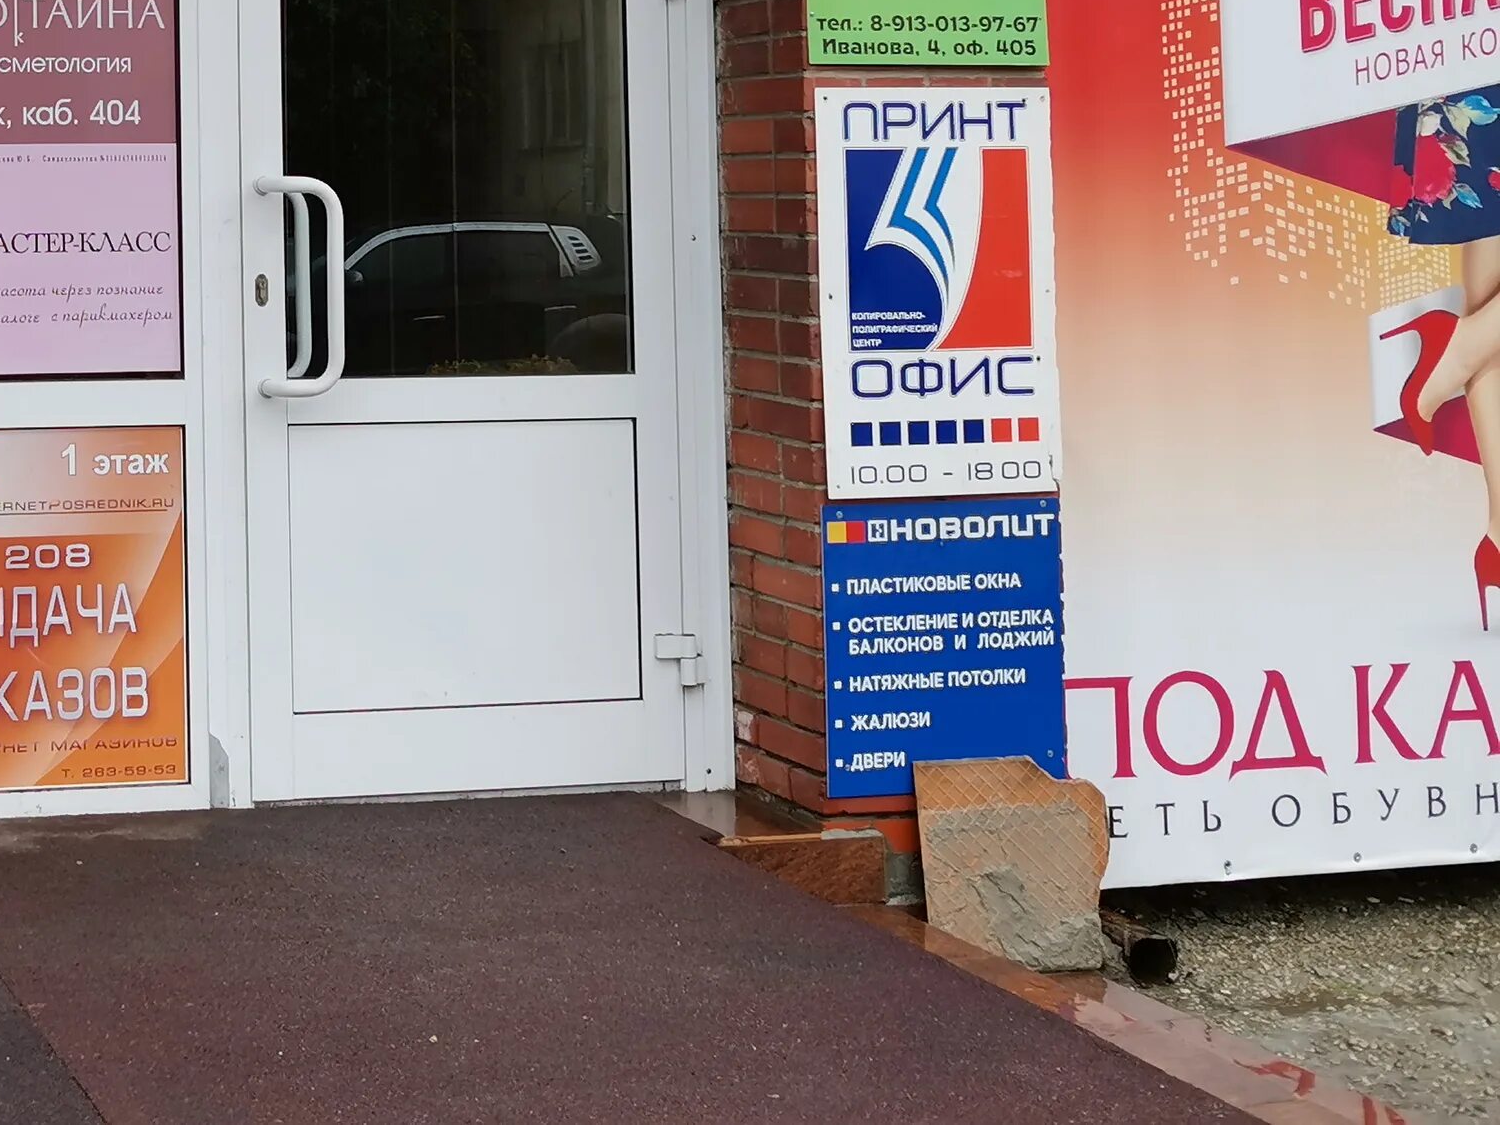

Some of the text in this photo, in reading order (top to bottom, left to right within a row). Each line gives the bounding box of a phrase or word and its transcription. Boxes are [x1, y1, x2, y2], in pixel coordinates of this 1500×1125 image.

[817, 15, 1038, 32] тел.: 8-913-013-97-67
[822, 38, 1036, 56] Иванова, 4, оф. 405
[1355, 28, 1497, 85] НОВАЯ КО
[22, 99, 78, 126] каб.
[89, 100, 141, 126] 404
[843, 102, 1026, 141] ПРИНТ
[51, 284, 92, 305] через
[96, 280, 163, 296] познание
[62, 303, 172, 327] парикмахером
[852, 312, 926, 320] КОПИРОВАЛЬНО-
[853, 323, 938, 333] ПОЛИГРАФИЧЕСКИЙ
[853, 339, 882, 347] ЦЕНТР
[851, 355, 1034, 399] ОФИС
[60, 442, 169, 477] 1 этаж
[851, 464, 927, 485] 10.00
[891, 514, 1055, 542] НОВОЛИТ
[5, 543, 91, 570] 208
[847, 573, 1022, 595] ПЛАСТИКОВЫЕ ОКНА
[848, 609, 1054, 633] ОСТЕКЛЕНИЕ И ОТДЕЛКА
[849, 627, 1054, 655] БАЛКОНОВ И ЛОДЖИЙ
[849, 668, 1026, 692] НАТЯЖНЫЕ ПОТОЛКИ
[851, 712, 931, 731] ЖАЛЮЗИ
[851, 751, 906, 772] ДВЕРИ
